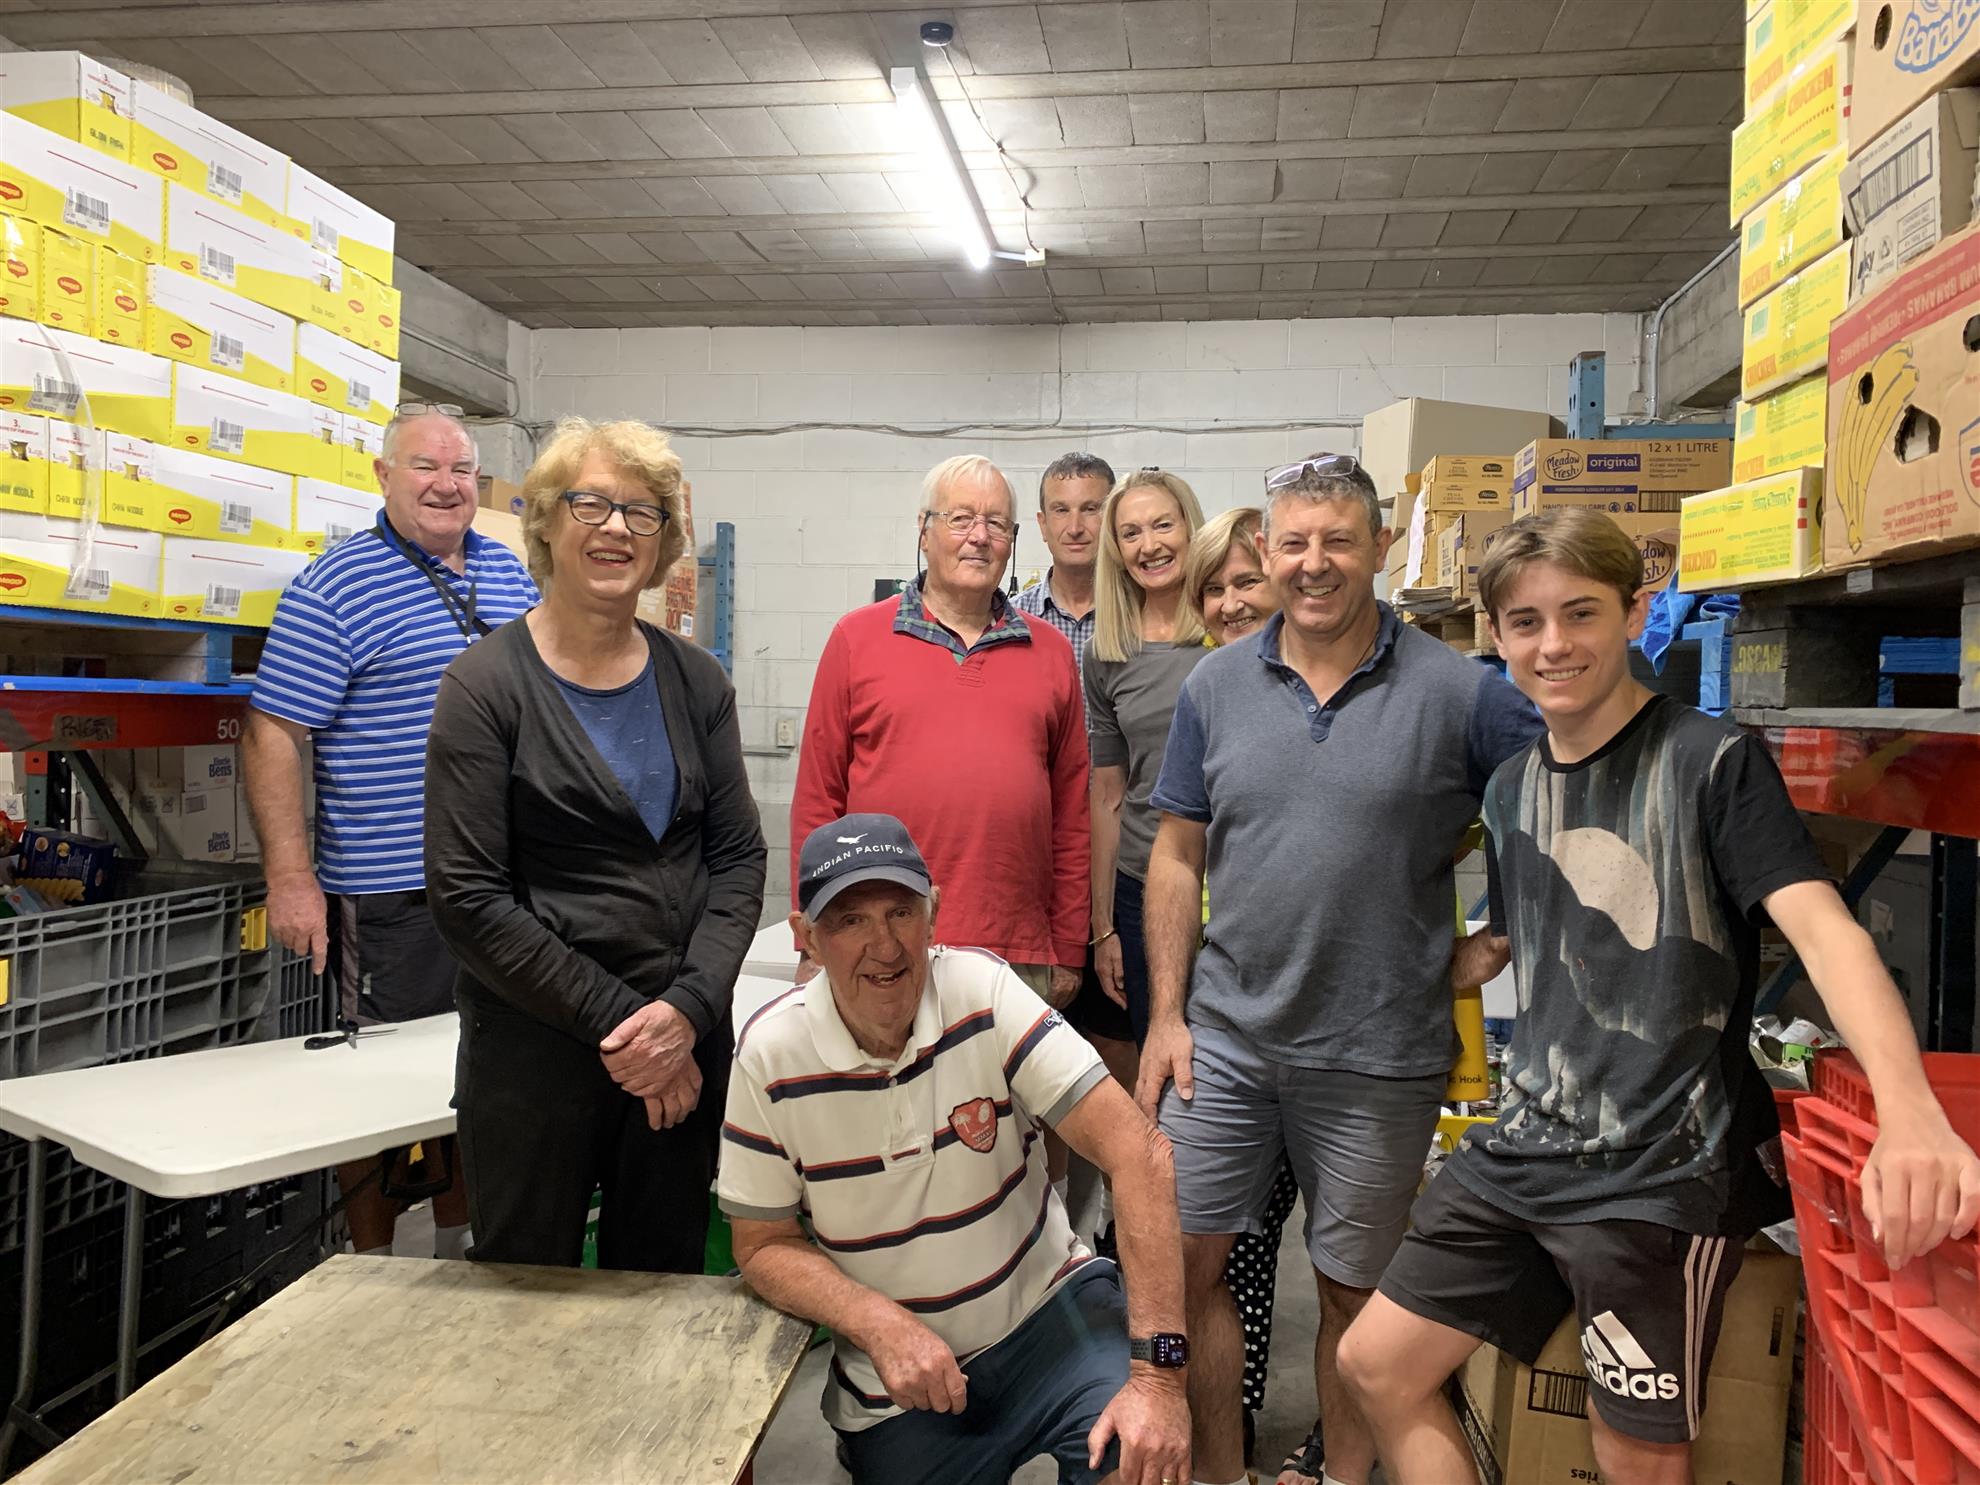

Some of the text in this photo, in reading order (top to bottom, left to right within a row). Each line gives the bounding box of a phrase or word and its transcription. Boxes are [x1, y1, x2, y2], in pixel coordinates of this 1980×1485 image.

[1648, 443, 1662, 453] 12
[1686, 443, 1718, 453] LITRE
[1546, 452, 1580, 470] Meadow
[1589, 456, 1638, 470] original
[1642, 540, 1666, 559] dow
[217, 719, 240, 740] 50
[812, 850, 851, 877] INDIAN
[1459, 1074, 1482, 1084] Hook
[1585, 1353, 1680, 1400] didas
[1570, 1468, 1601, 1484] ries
